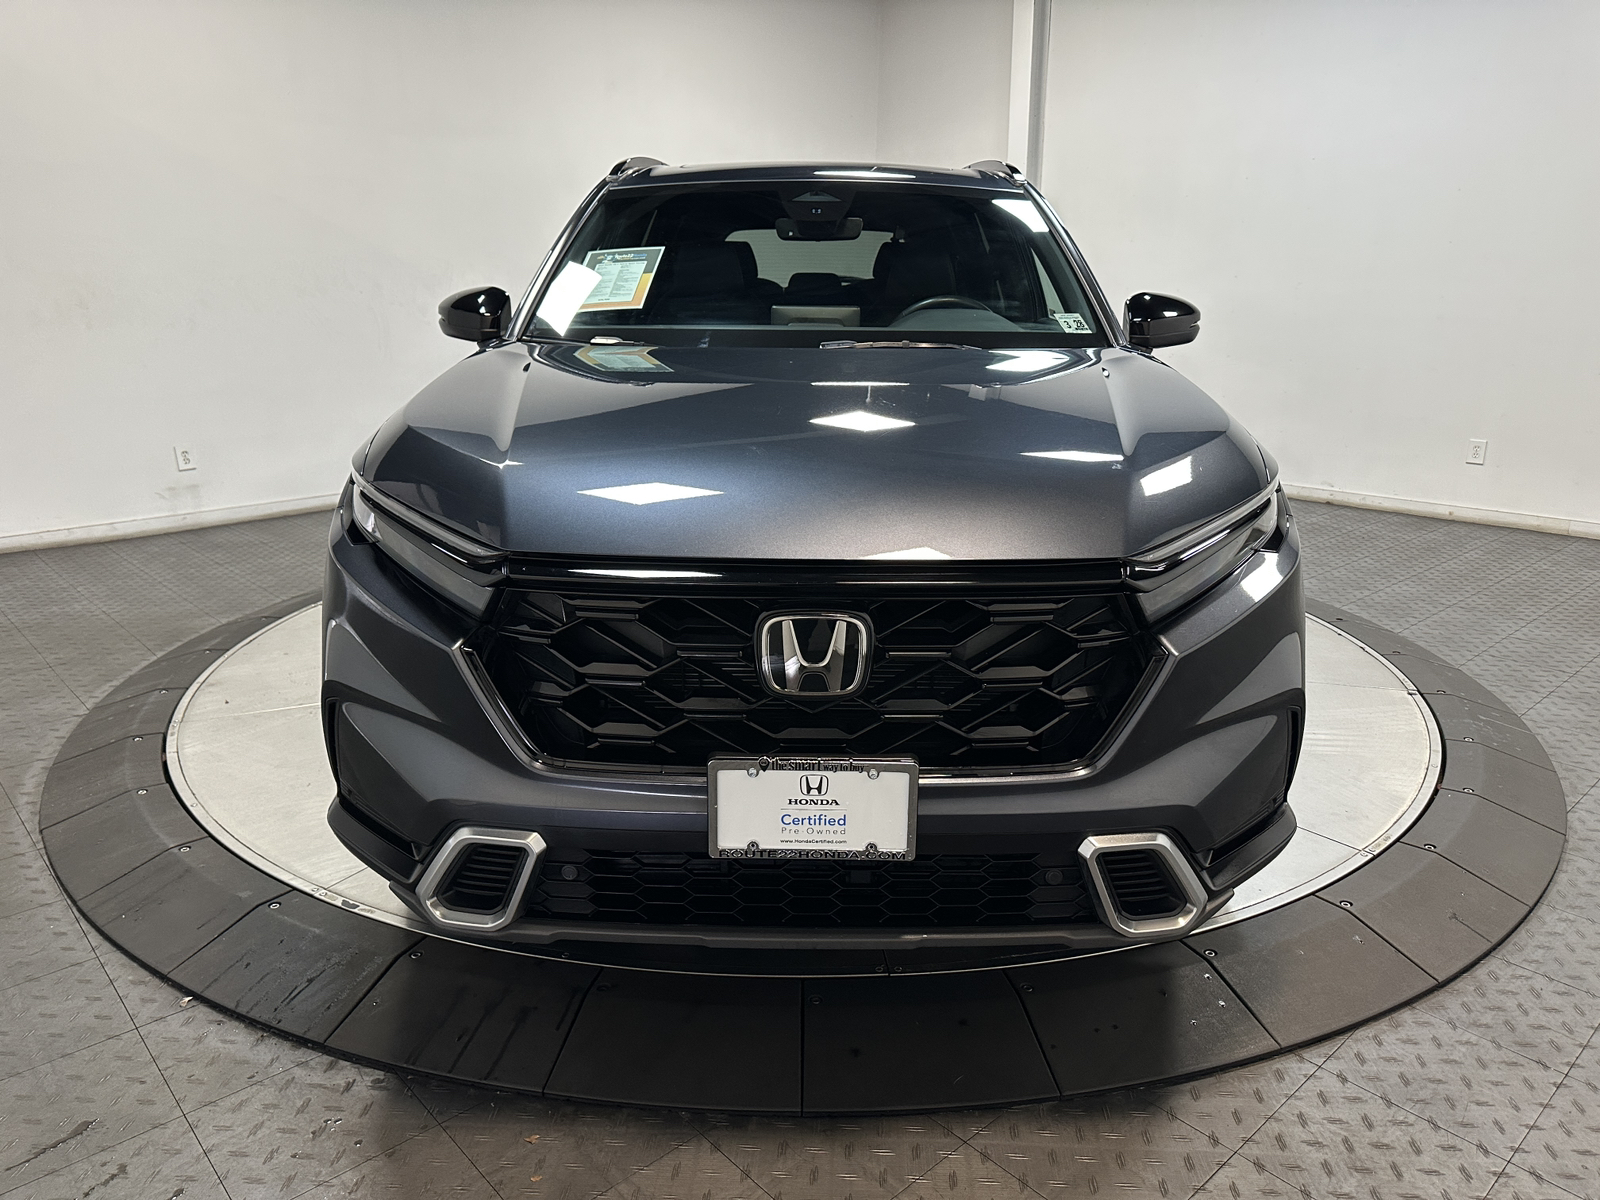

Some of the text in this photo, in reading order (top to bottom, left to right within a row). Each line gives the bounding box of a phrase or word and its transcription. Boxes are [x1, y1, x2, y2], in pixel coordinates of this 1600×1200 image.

[1064, 321, 1072, 329] 3
[788, 759, 821, 771] smart
[822, 763, 839, 773] way
[849, 760, 865, 773] buy
[787, 798, 840, 806] HONDA
[780, 813, 847, 826] Certified
[781, 827, 846, 835] Pre-Owned
[718, 849, 906, 860] ROUTE22HONDA.COM
